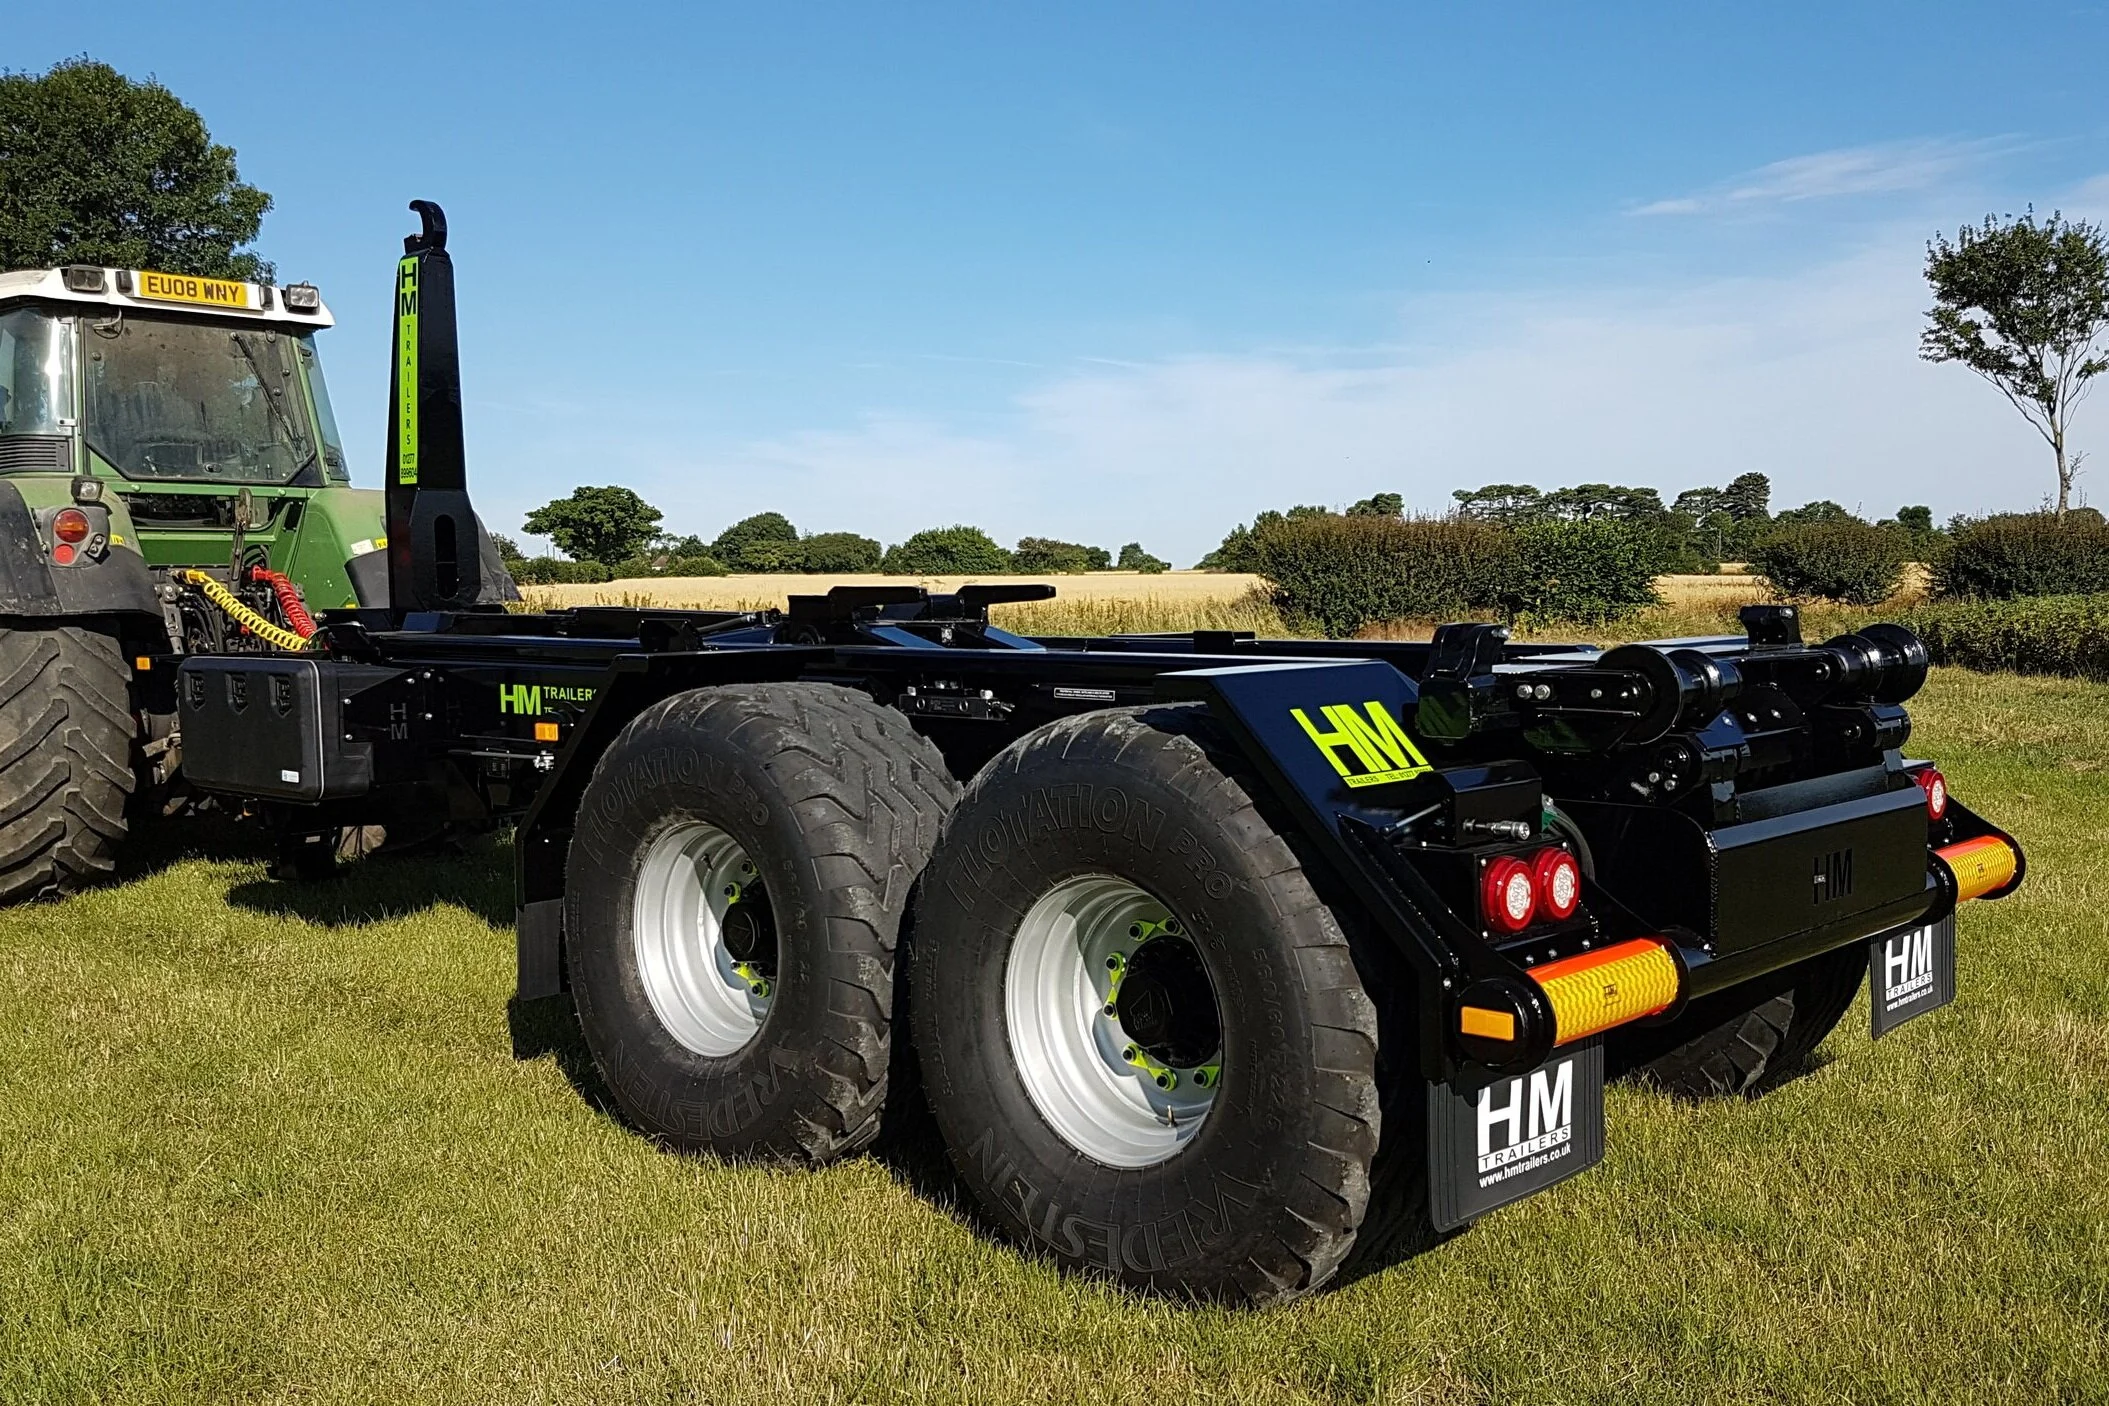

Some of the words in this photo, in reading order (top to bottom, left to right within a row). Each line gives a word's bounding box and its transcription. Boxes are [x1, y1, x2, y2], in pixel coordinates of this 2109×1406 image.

[147, 275, 198, 298] EU08
[203, 282, 239, 303] WNY
[401, 262, 417, 317] HM
[500, 683, 542, 716] HM
[543, 686, 597, 701] TRAILER
[1289, 700, 1429, 777] HM
[1346, 775, 1381, 787] TRAILERS
[1168, 826, 1232, 900] PRO
[1812, 847, 1853, 905] HM
[1885, 924, 1933, 990] HM
[1887, 973, 1932, 998] TRAILERS
[1477, 1059, 1573, 1157] HM
[1478, 1141, 1572, 1189] www.hmtrailers.co.uk
[1481, 1127, 1570, 1170] TRAILERS
